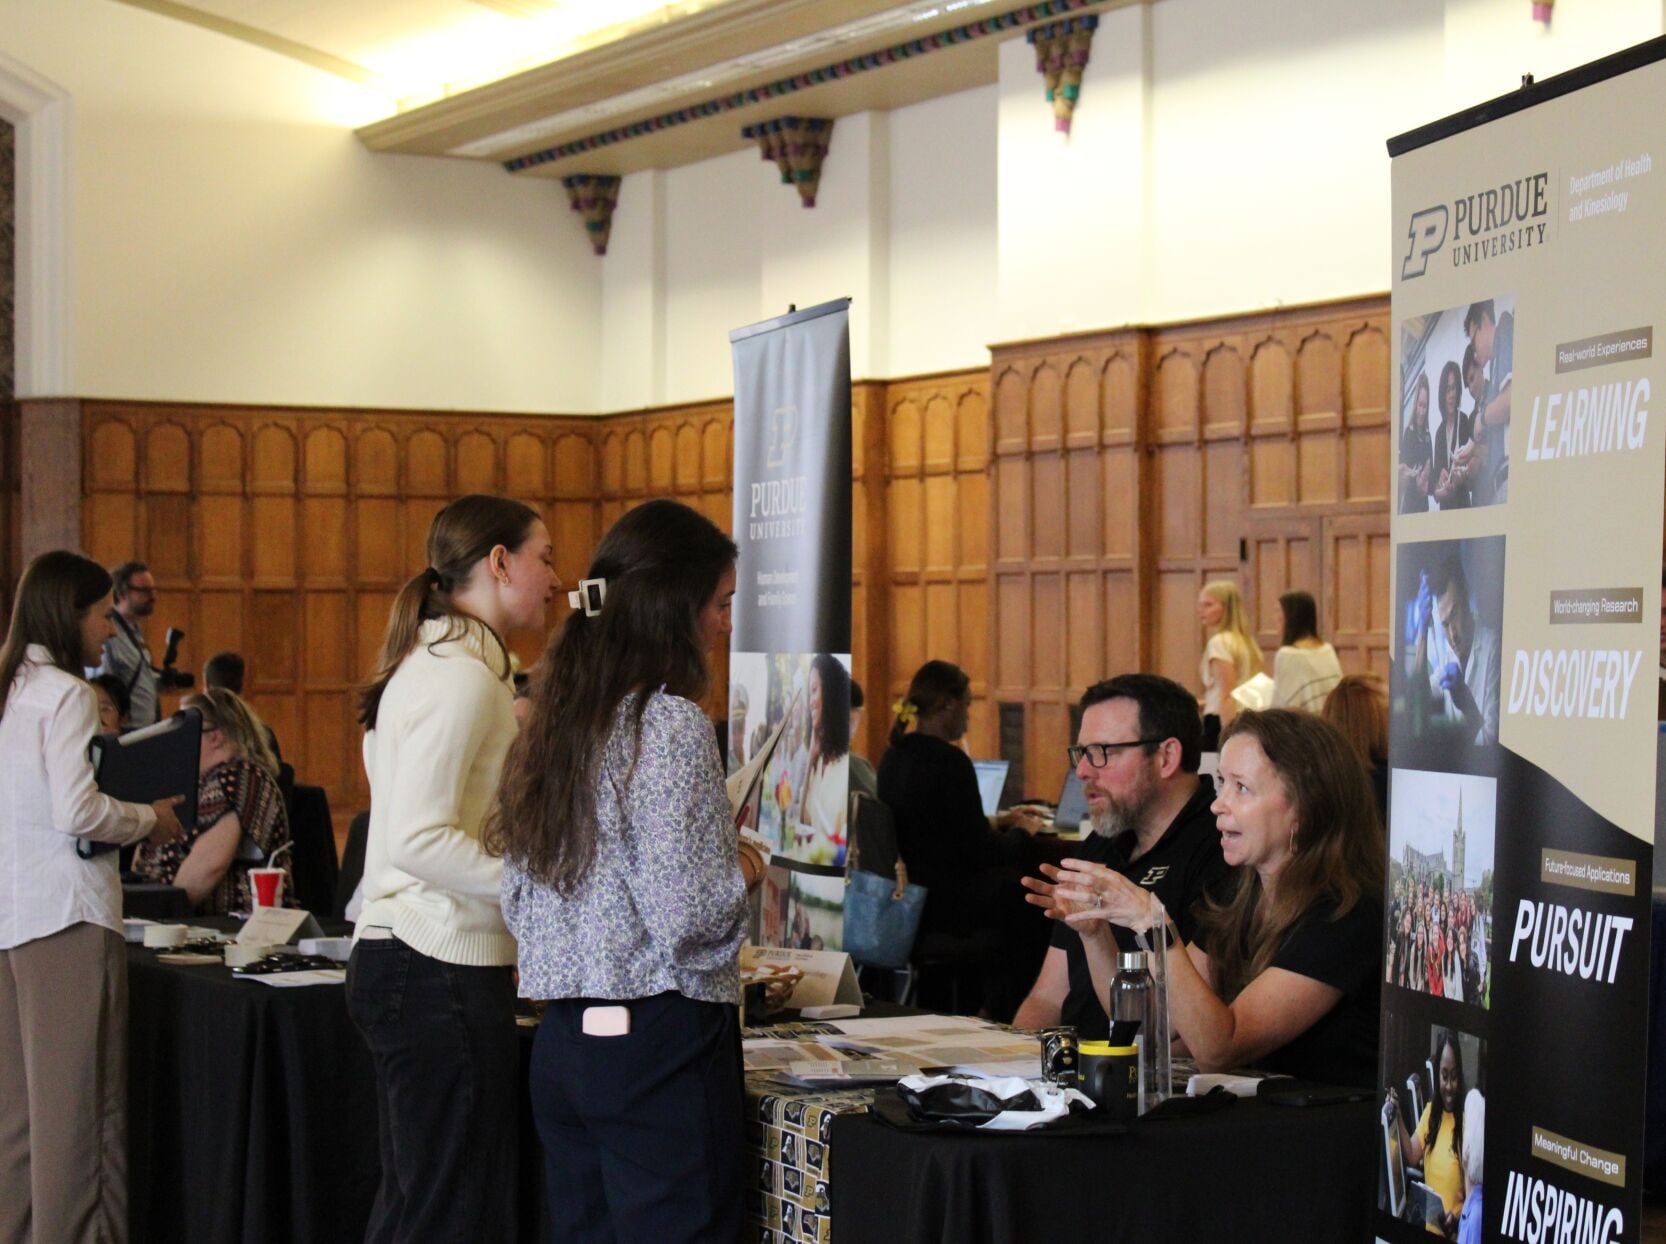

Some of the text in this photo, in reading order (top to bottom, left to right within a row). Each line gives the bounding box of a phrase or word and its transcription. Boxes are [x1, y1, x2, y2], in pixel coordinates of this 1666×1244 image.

[1568, 153, 1652, 197] Department of Health
[1453, 172, 1548, 240] PURDUE
[1567, 191, 1628, 223] and Kinesiology
[1453, 223, 1547, 267] UNIVERSITY
[1559, 338, 1648, 364] Real-world Experiences
[1526, 377, 1650, 462] LEARNING
[750, 477, 808, 518] PURDUE
[1554, 597, 1639, 616] World-changing Research
[1507, 648, 1643, 720] DISCOVERY
[1545, 857, 1631, 885] Future-focused Applications
[1509, 899, 1634, 984] PURSUIT
[1534, 1133, 1620, 1175] Meaningful Change
[1500, 1170, 1625, 1244] INSPIRING
